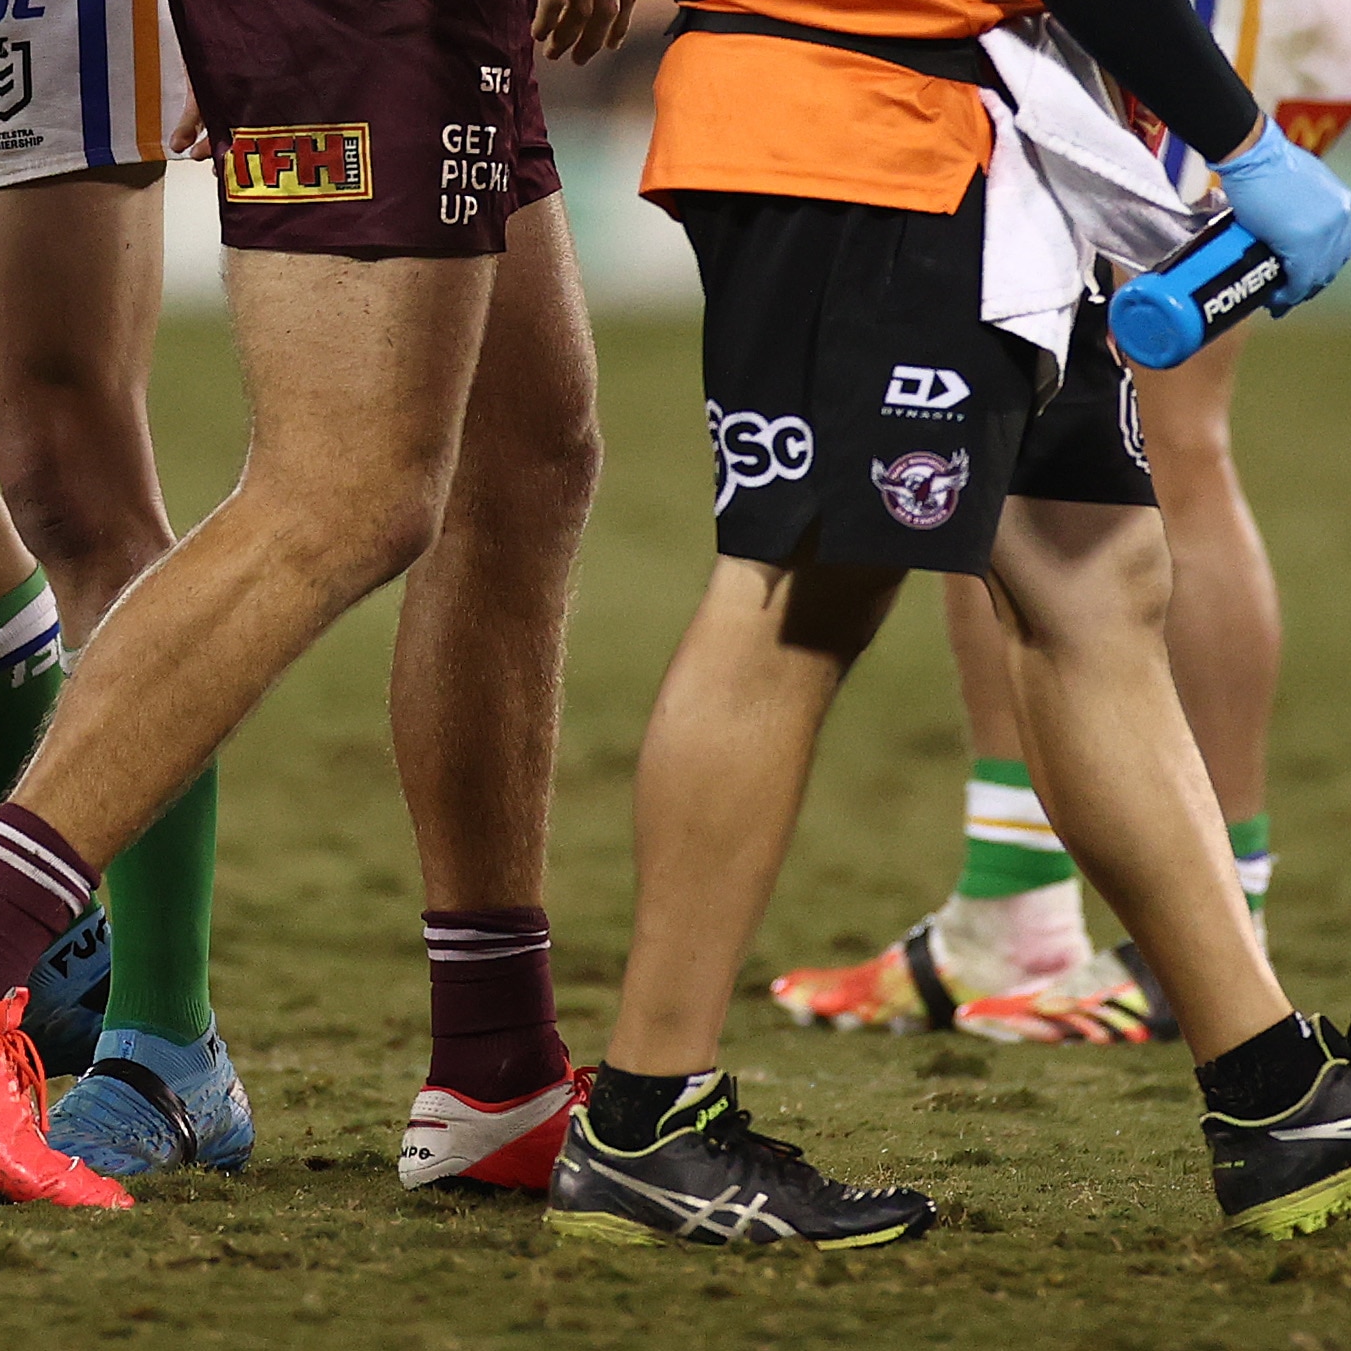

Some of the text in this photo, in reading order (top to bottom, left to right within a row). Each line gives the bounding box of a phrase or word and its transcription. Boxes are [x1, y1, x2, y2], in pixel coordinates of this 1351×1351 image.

[442, 124, 497, 154] GET
[230, 133, 359, 189] TFH HIRE
[440, 195, 478, 225] UP
